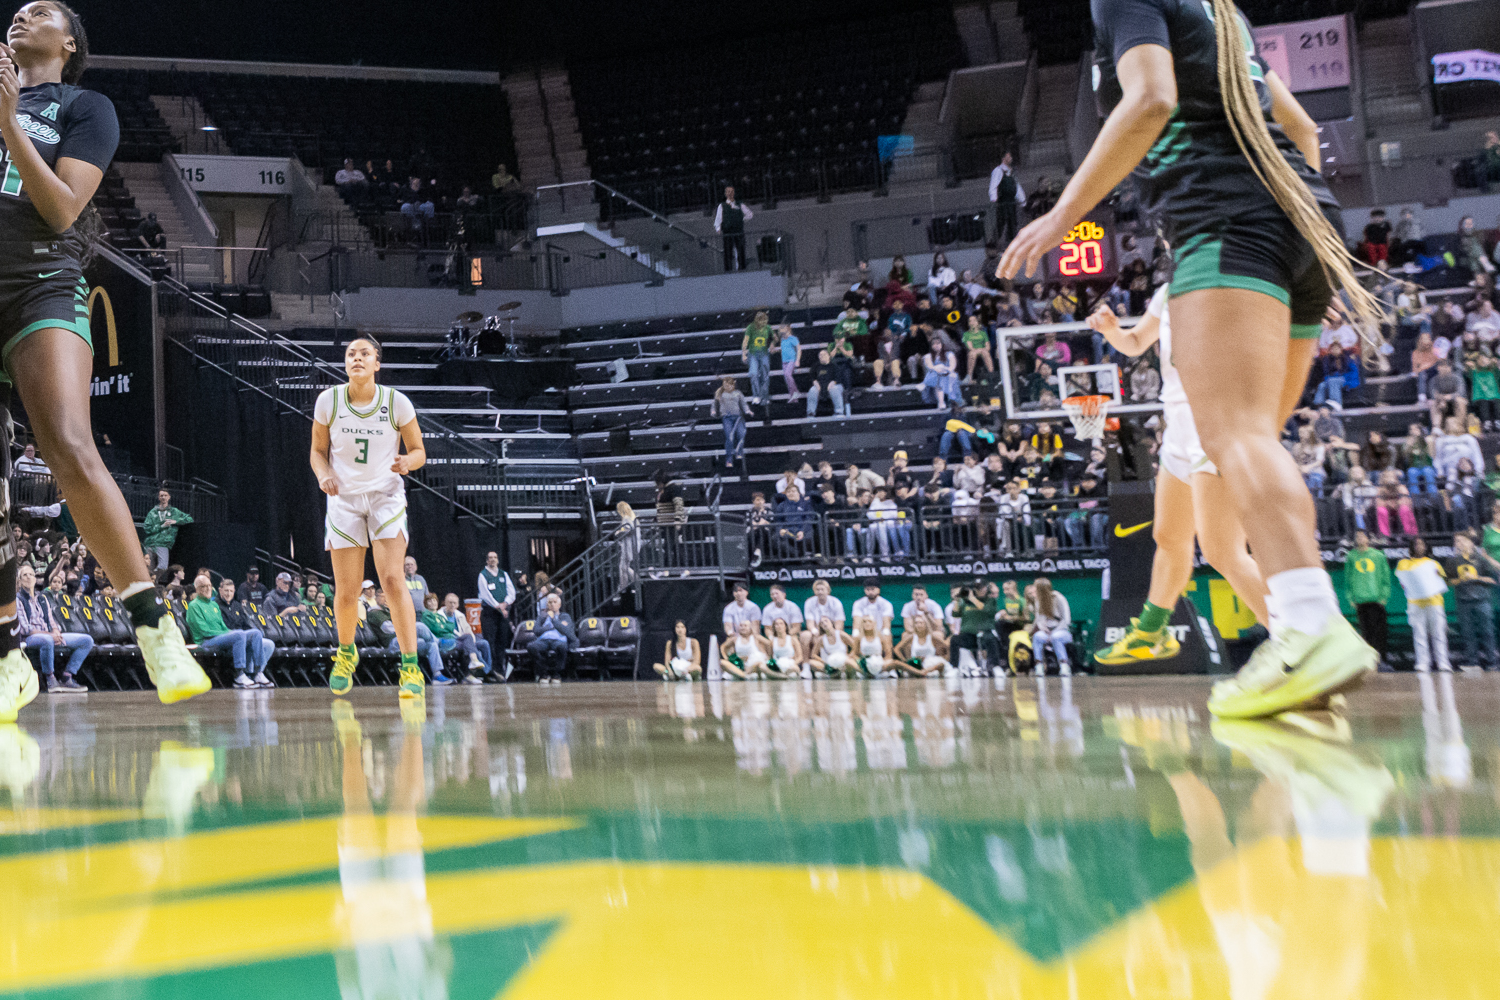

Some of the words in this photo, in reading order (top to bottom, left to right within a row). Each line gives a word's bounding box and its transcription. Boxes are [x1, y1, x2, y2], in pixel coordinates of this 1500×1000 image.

[1300, 28, 1340, 50] 219
[259, 170, 286, 185] 116
[1059, 240, 1104, 276] 20
[117, 373, 130, 394] it
[341, 427, 384, 436] DUCKS
[354, 438, 369, 465] 3
[753, 570, 778, 580] TACO
[792, 569, 815, 579] BELL
[815, 568, 841, 578] TACO
[855, 567, 879, 577] BELL
[879, 566, 906, 576] TACO
[920, 564, 945, 575] BELL
[945, 563, 973, 574] TACO
[987, 562, 1013, 572] BELL
[1013, 561, 1041, 571] TACO
[1056, 559, 1082, 569] BELL
[1082, 558, 1111, 568] TACO
